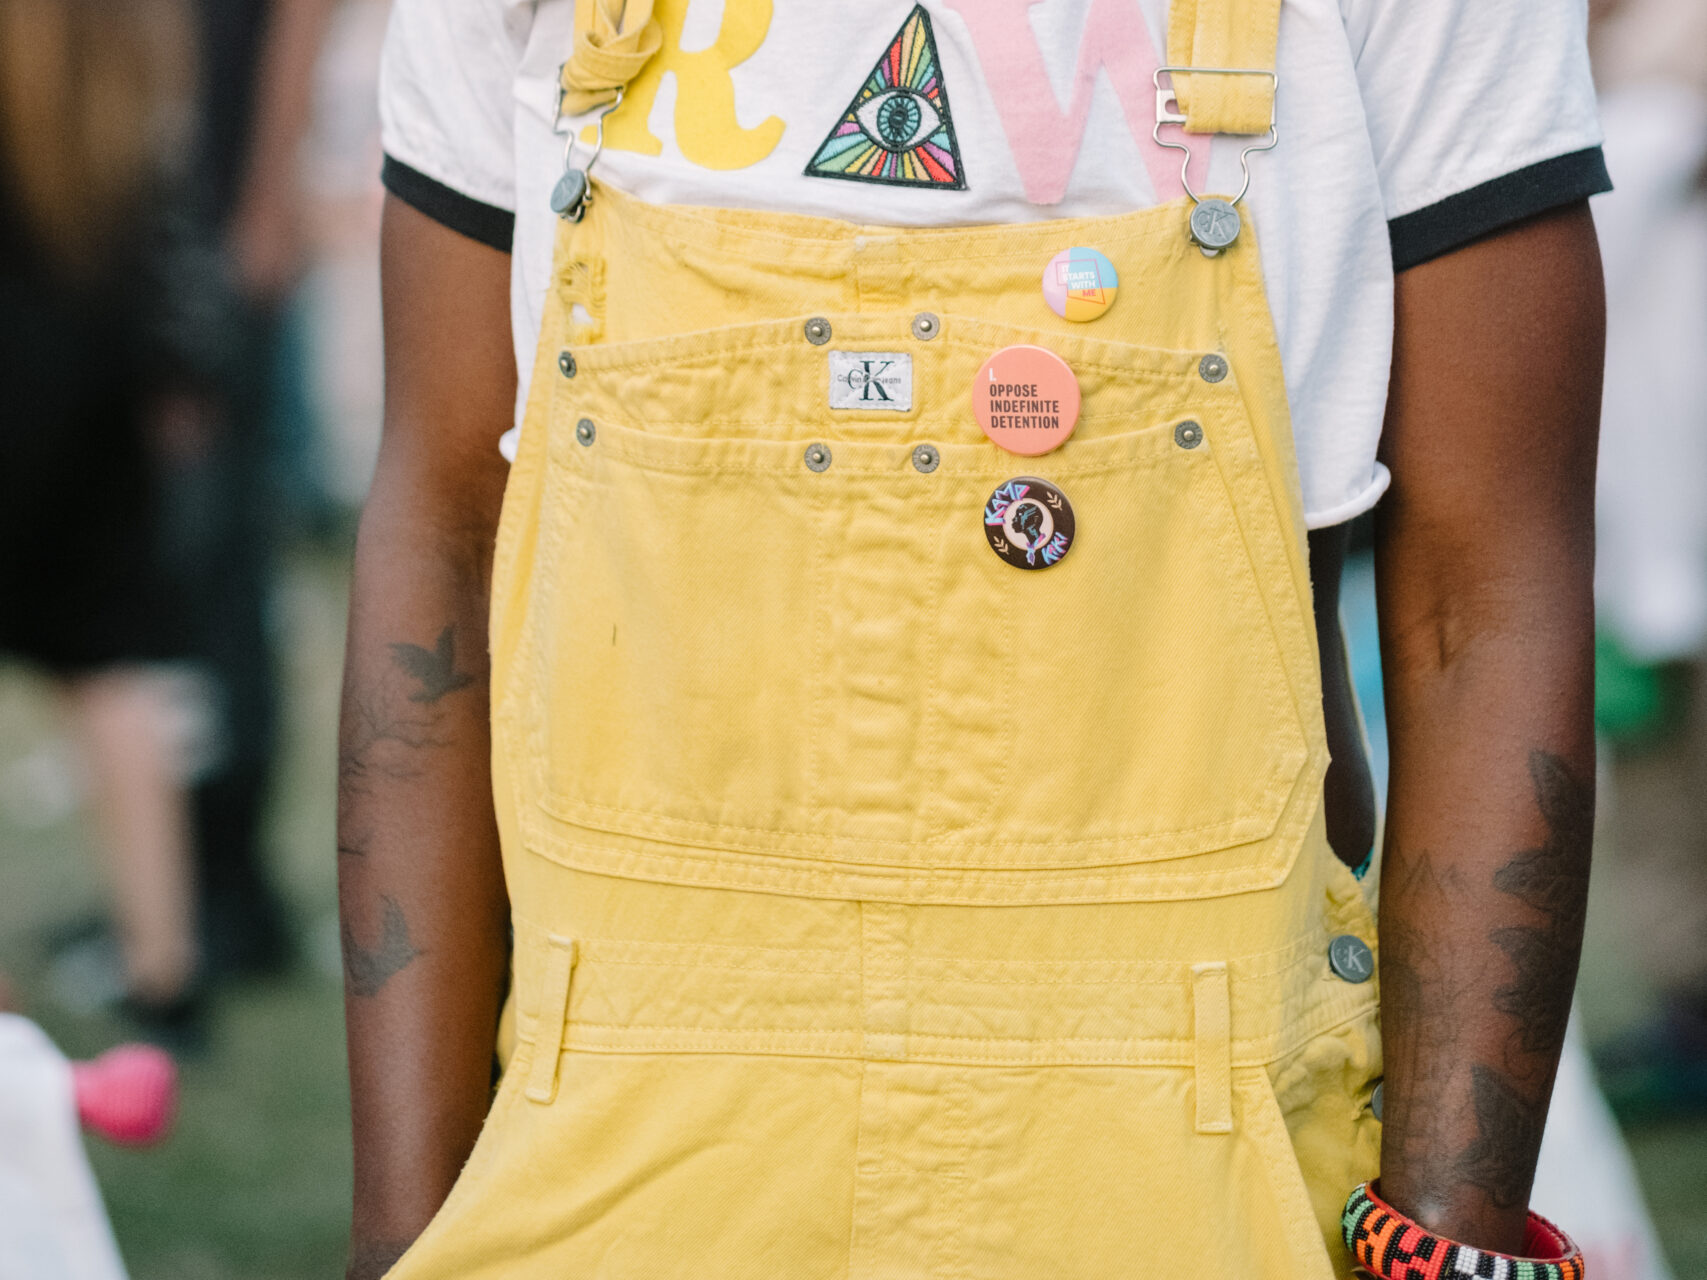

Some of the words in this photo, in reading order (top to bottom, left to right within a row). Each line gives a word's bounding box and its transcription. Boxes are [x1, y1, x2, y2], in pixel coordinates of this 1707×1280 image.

[1063, 271, 1095, 281] STARTS
[1071, 280, 1096, 289] WITH
[989, 384, 1038, 397] OPPOSE
[990, 400, 1059, 413] INDEFINITE
[991, 415, 1059, 429] DETENTION
[985, 482, 1030, 526] KAMP
